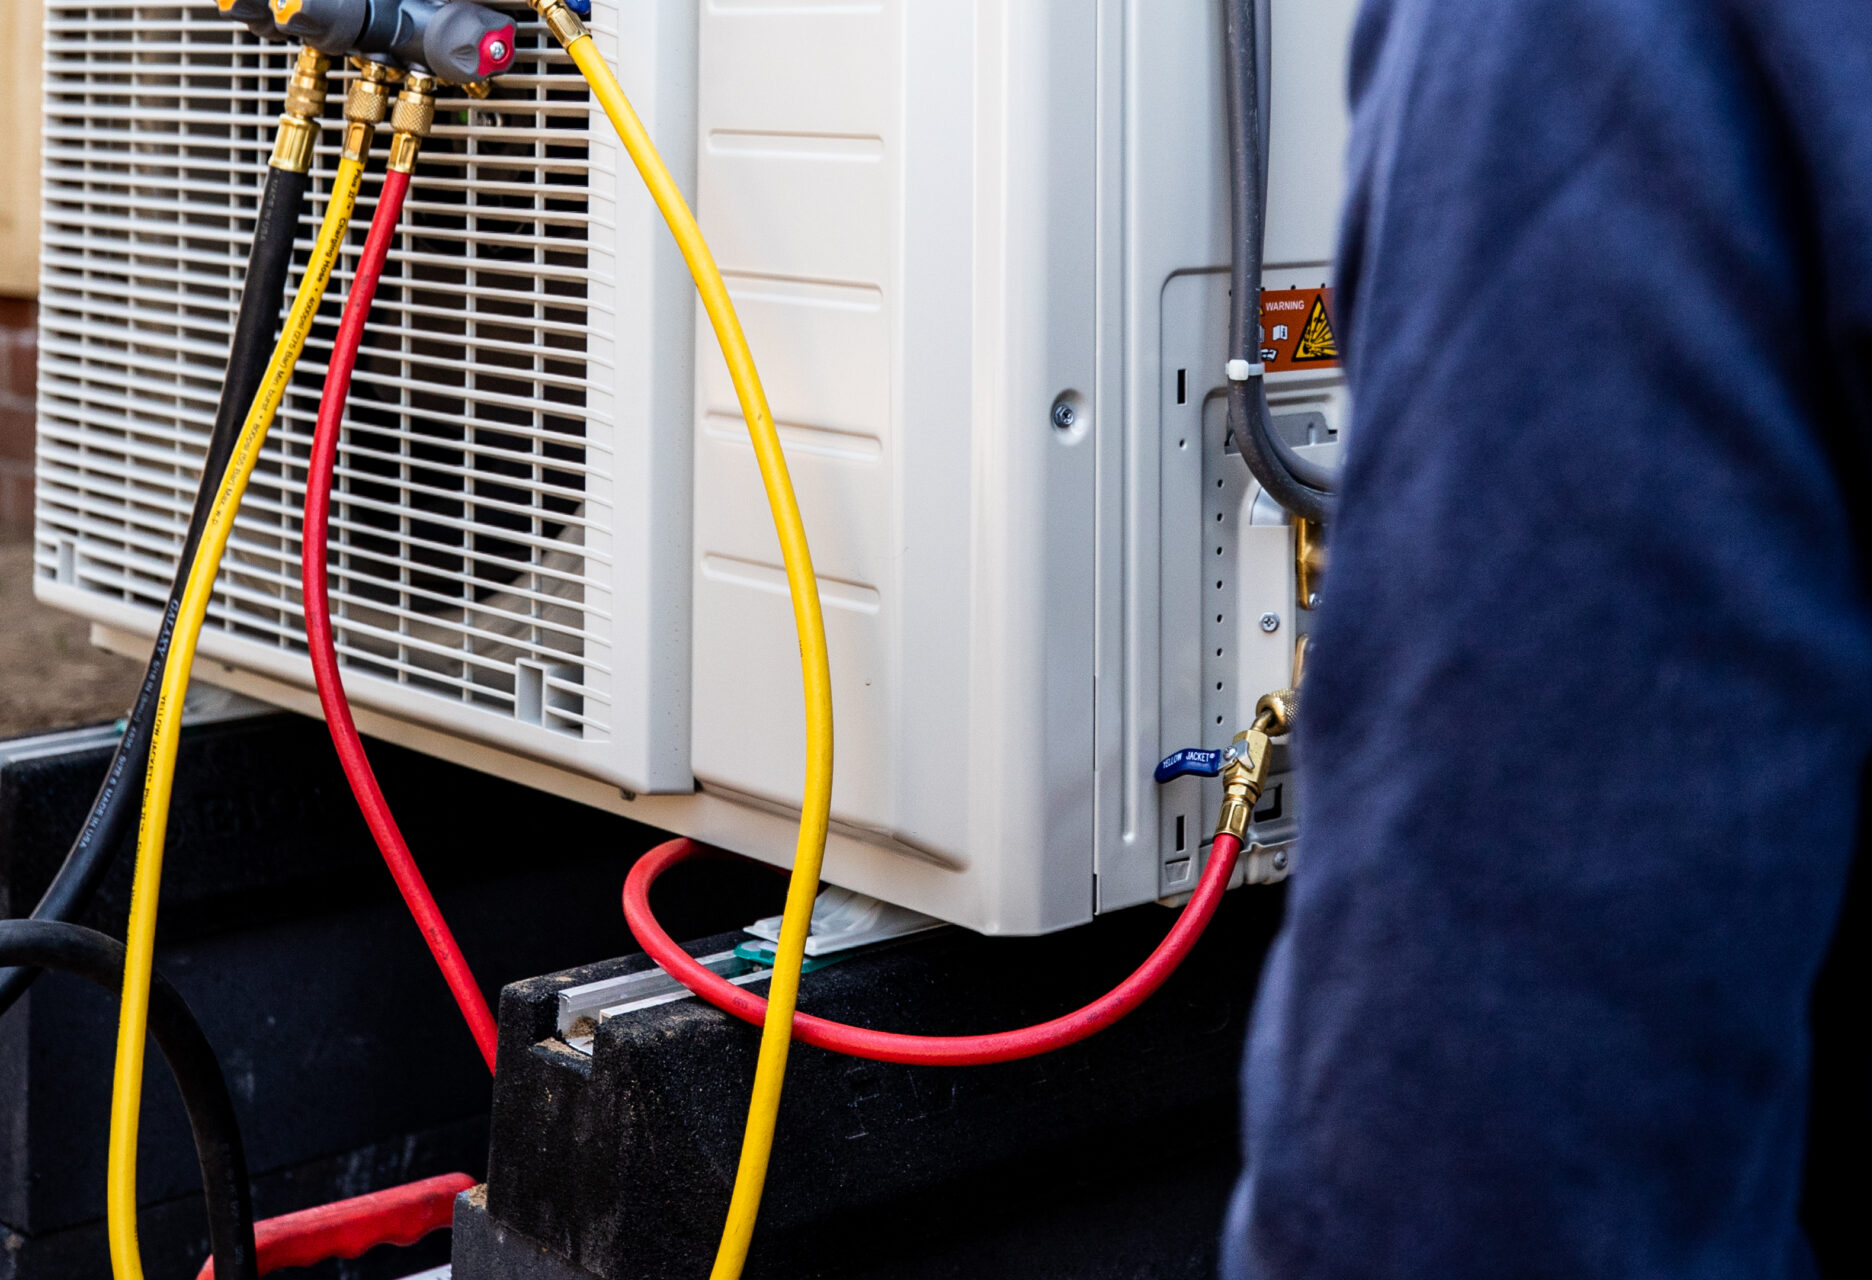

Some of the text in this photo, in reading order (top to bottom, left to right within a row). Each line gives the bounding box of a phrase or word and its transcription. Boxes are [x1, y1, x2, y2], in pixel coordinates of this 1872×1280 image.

[326, 217, 346, 258] Charging
[317, 260, 331, 282] Hose
[1265, 300, 1305, 311] WARNING
[157, 599, 179, 657] GALAXY
[1162, 752, 1183, 769] YELLOW
[95, 787, 113, 817] MADE
[79, 828, 94, 848] USA
